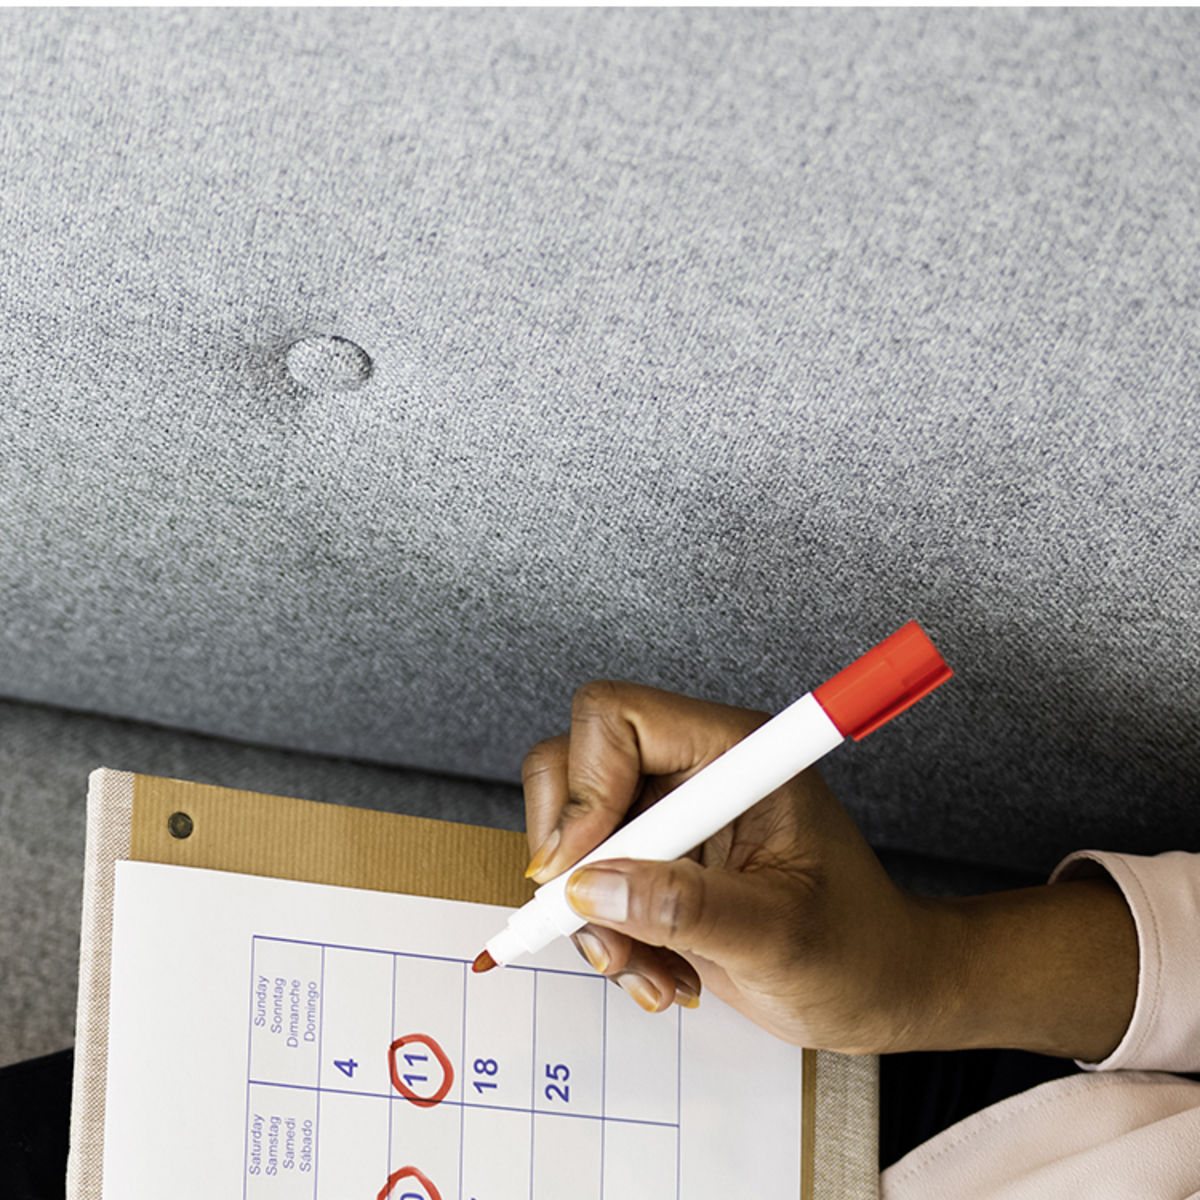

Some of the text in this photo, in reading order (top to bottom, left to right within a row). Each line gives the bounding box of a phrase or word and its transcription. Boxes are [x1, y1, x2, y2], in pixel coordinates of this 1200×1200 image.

[253, 974, 270, 1028] Sunday
[270, 977, 285, 1034] Sonntag
[287, 978, 301, 1048] Dimanche
[303, 981, 318, 1042] Domingo
[333, 1058, 359, 1078] 4
[403, 1052, 428, 1087] 11
[473, 1058, 499, 1094] 18
[545, 1063, 571, 1103] 25
[249, 1114, 263, 1176] Saturday
[266, 1116, 281, 1177] Samstag
[283, 1117, 296, 1170] Samedi
[299, 1119, 313, 1172] Sábado
